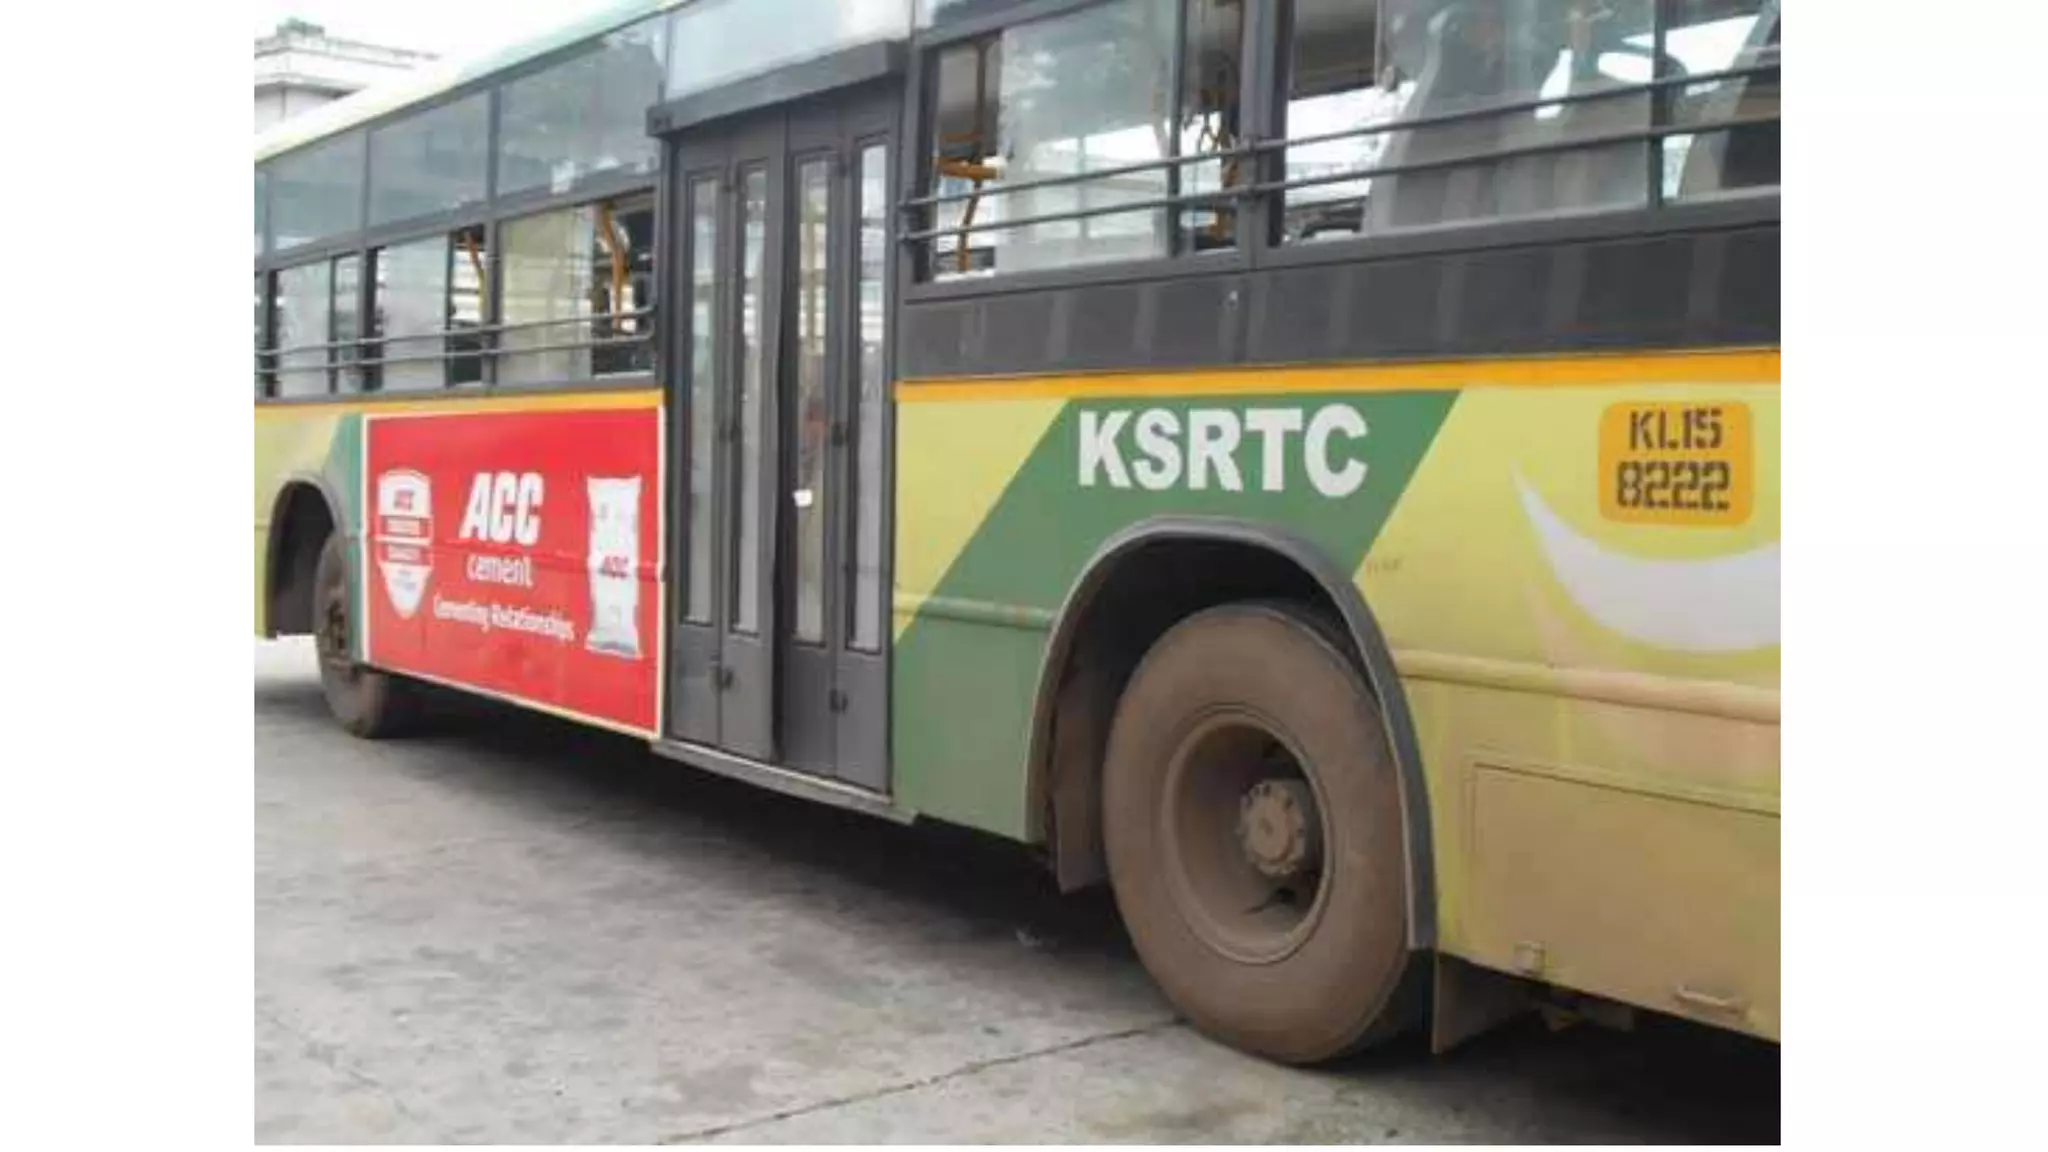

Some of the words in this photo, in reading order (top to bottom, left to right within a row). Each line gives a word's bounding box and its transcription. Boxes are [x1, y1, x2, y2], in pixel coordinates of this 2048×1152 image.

[1078, 404, 1369, 498] KSRTC
[1629, 407, 1723, 450] KL15
[459, 471, 544, 546] ACC
[1616, 461, 1731, 511] 8222
[466, 553, 534, 588] cement
